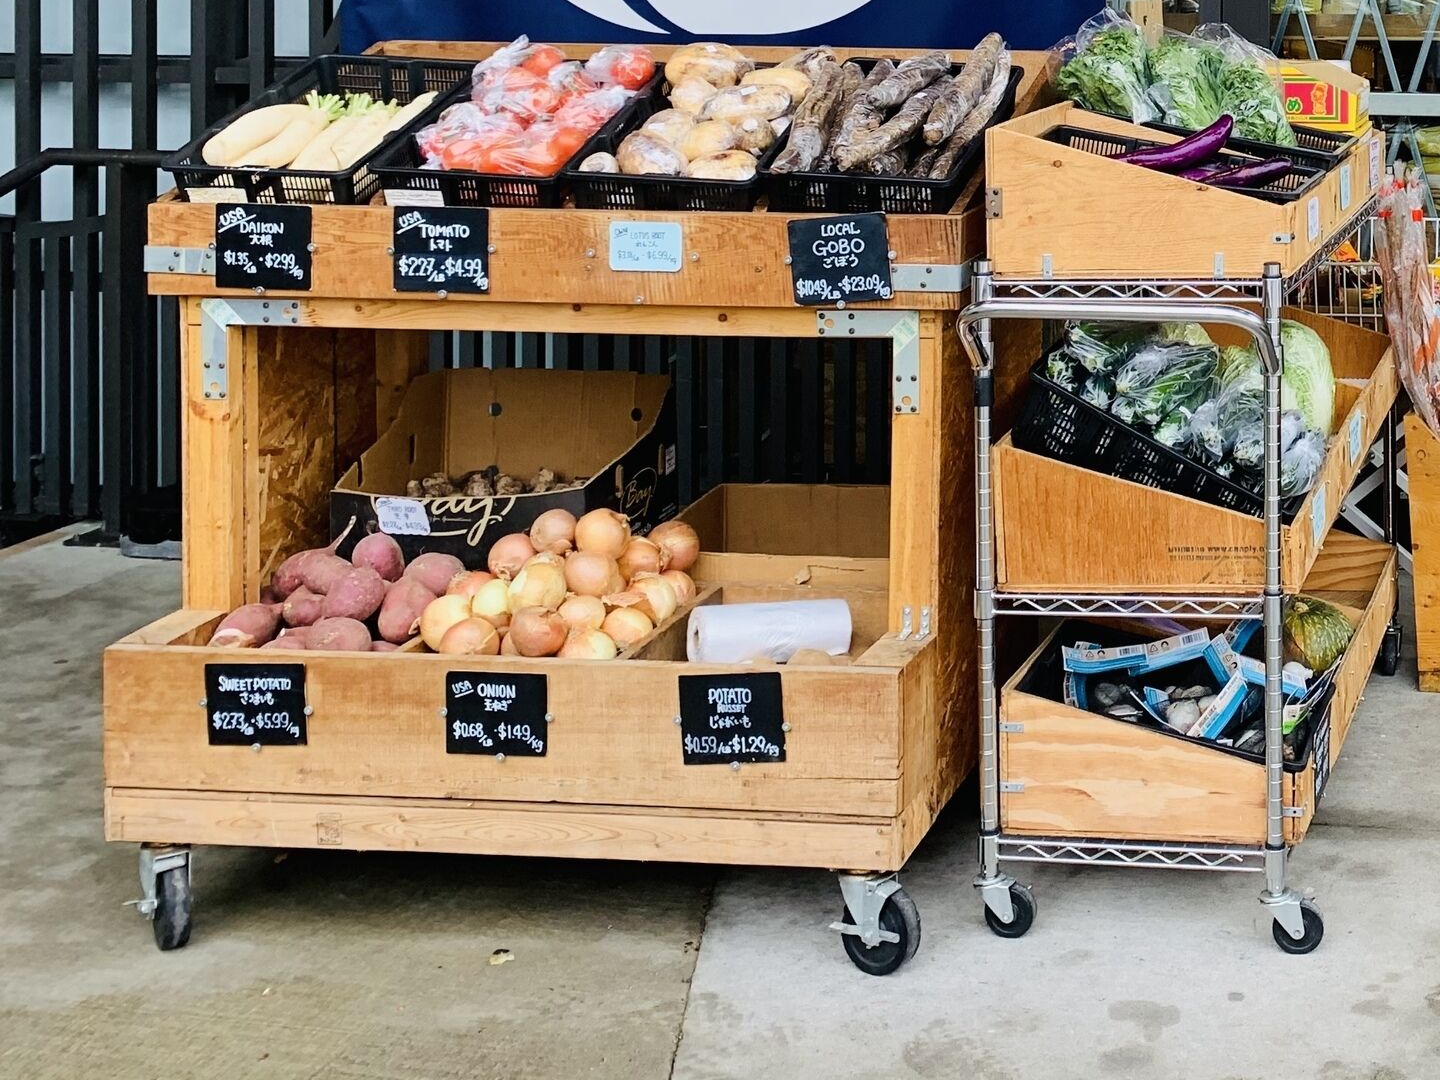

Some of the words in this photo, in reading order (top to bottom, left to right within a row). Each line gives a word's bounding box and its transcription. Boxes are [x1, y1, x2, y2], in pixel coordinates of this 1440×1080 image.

[218, 207, 247, 226] USA
[398, 210, 422, 228] USA
[239, 221, 285, 235] DAIKON
[418, 223, 470, 238] TOMATO
[820, 222, 861, 237] LOCAL
[249, 233, 274, 247] 大根
[429, 238, 453, 252] トマト
[812, 238, 865, 256] GOBO
[822, 254, 859, 269] ごぼう
[218, 675, 253, 692] SWEET
[253, 677, 291, 691] POTATO
[451, 680, 473, 694] USA
[477, 683, 516, 699] ONION
[708, 687, 752, 704] POTATO
[716, 703, 747, 714] RUSSET
[709, 715, 752, 729] じゃがいも
